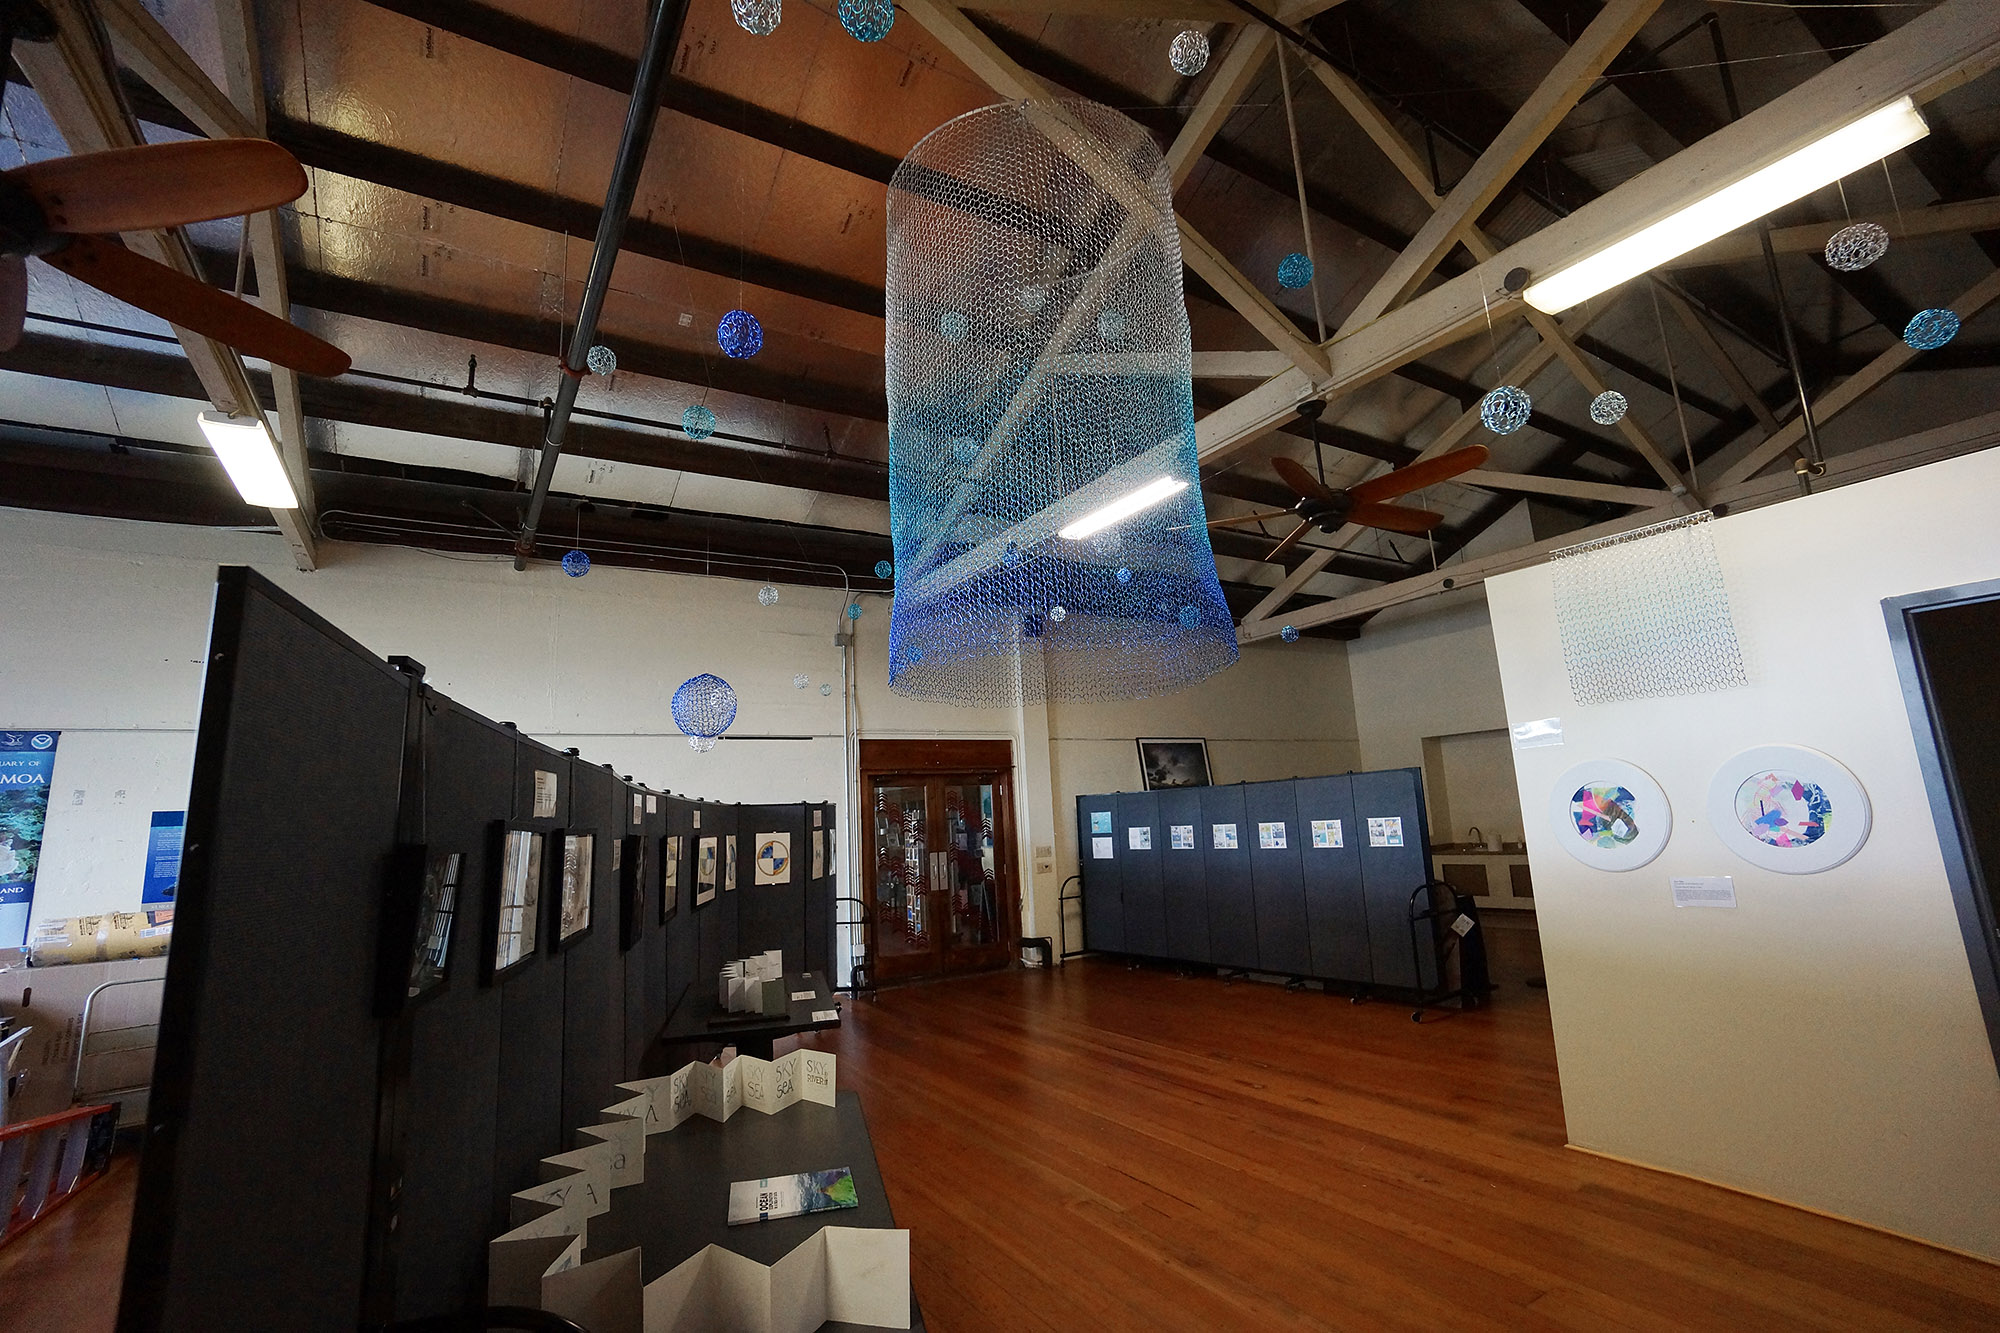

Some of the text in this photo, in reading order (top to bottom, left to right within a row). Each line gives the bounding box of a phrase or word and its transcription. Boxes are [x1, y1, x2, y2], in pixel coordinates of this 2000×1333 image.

[0, 773, 45, 784] MOA
[775, 1058, 797, 1083] SKY
[759, 1192, 769, 1212] OCEAN
